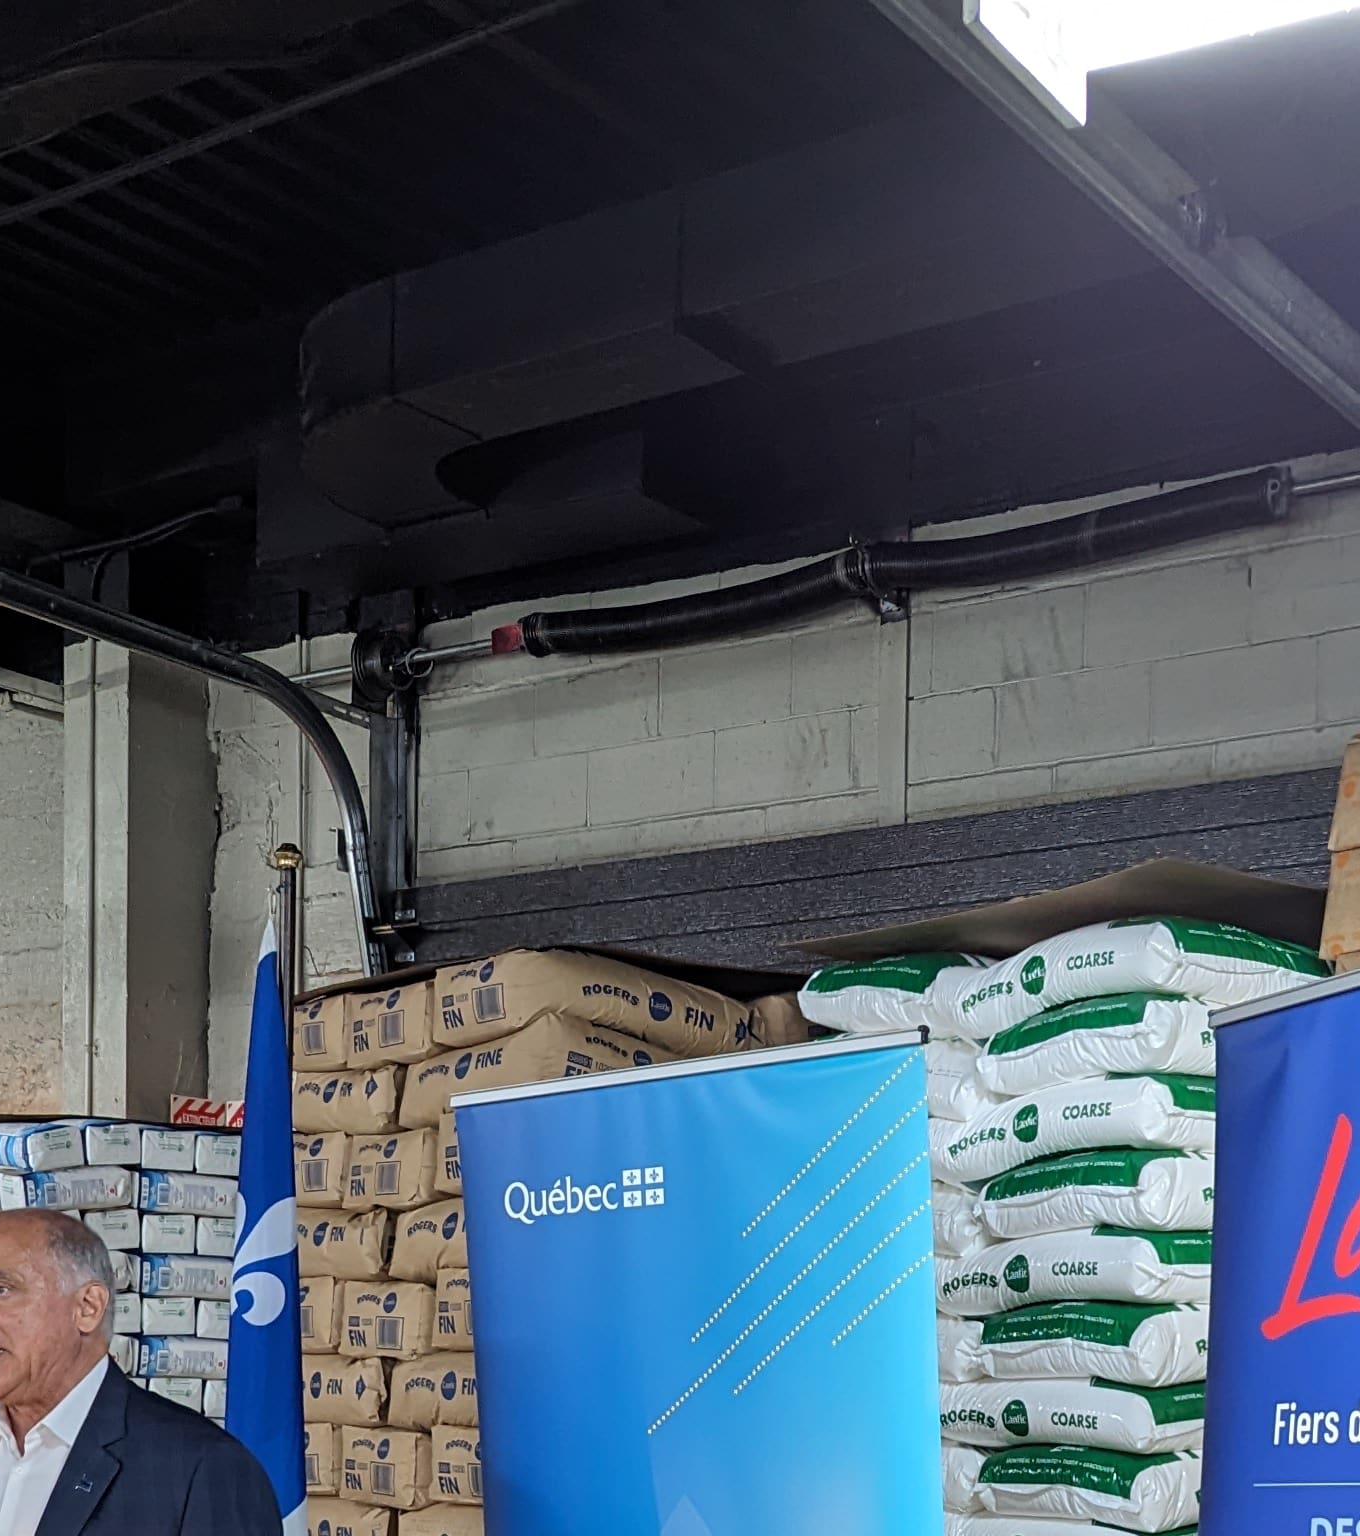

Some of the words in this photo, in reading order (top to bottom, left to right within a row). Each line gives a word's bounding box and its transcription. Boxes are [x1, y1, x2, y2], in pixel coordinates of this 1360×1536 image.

[962, 979, 1014, 1013] ROGERS
[1067, 950, 1115, 971] COARSE
[582, 984, 639, 1006] ROGERS
[684, 1007, 715, 1031] FIN
[442, 1008, 464, 1029] FIN
[353, 1032, 369, 1053] FIN
[475, 1047, 503, 1070] FINE
[947, 1127, 1007, 1158] ROGERS
[1062, 1102, 1112, 1121] COARSE
[350, 1178, 365, 1197] FIN
[504, 1174, 618, 1224] Québec
[407, 1220, 437, 1237] ROGERS
[942, 1272, 998, 1296] ROGERS
[1005, 1267, 1028, 1280] Lantic
[1051, 1261, 1099, 1277] COARSE
[439, 1316, 456, 1334] FIN
[348, 1330, 367, 1347] FIN
[327, 1379, 342, 1395] FIN
[405, 1377, 436, 1392] ROGERS
[940, 1409, 996, 1429] ROGERS
[1003, 1412, 1027, 1425] Lantic
[1050, 1411, 1098, 1430] COARSE
[1273, 1402, 1339, 1447] Fiers
[345, 1472, 362, 1490] FIN
[438, 1476, 460, 1495] FIN
